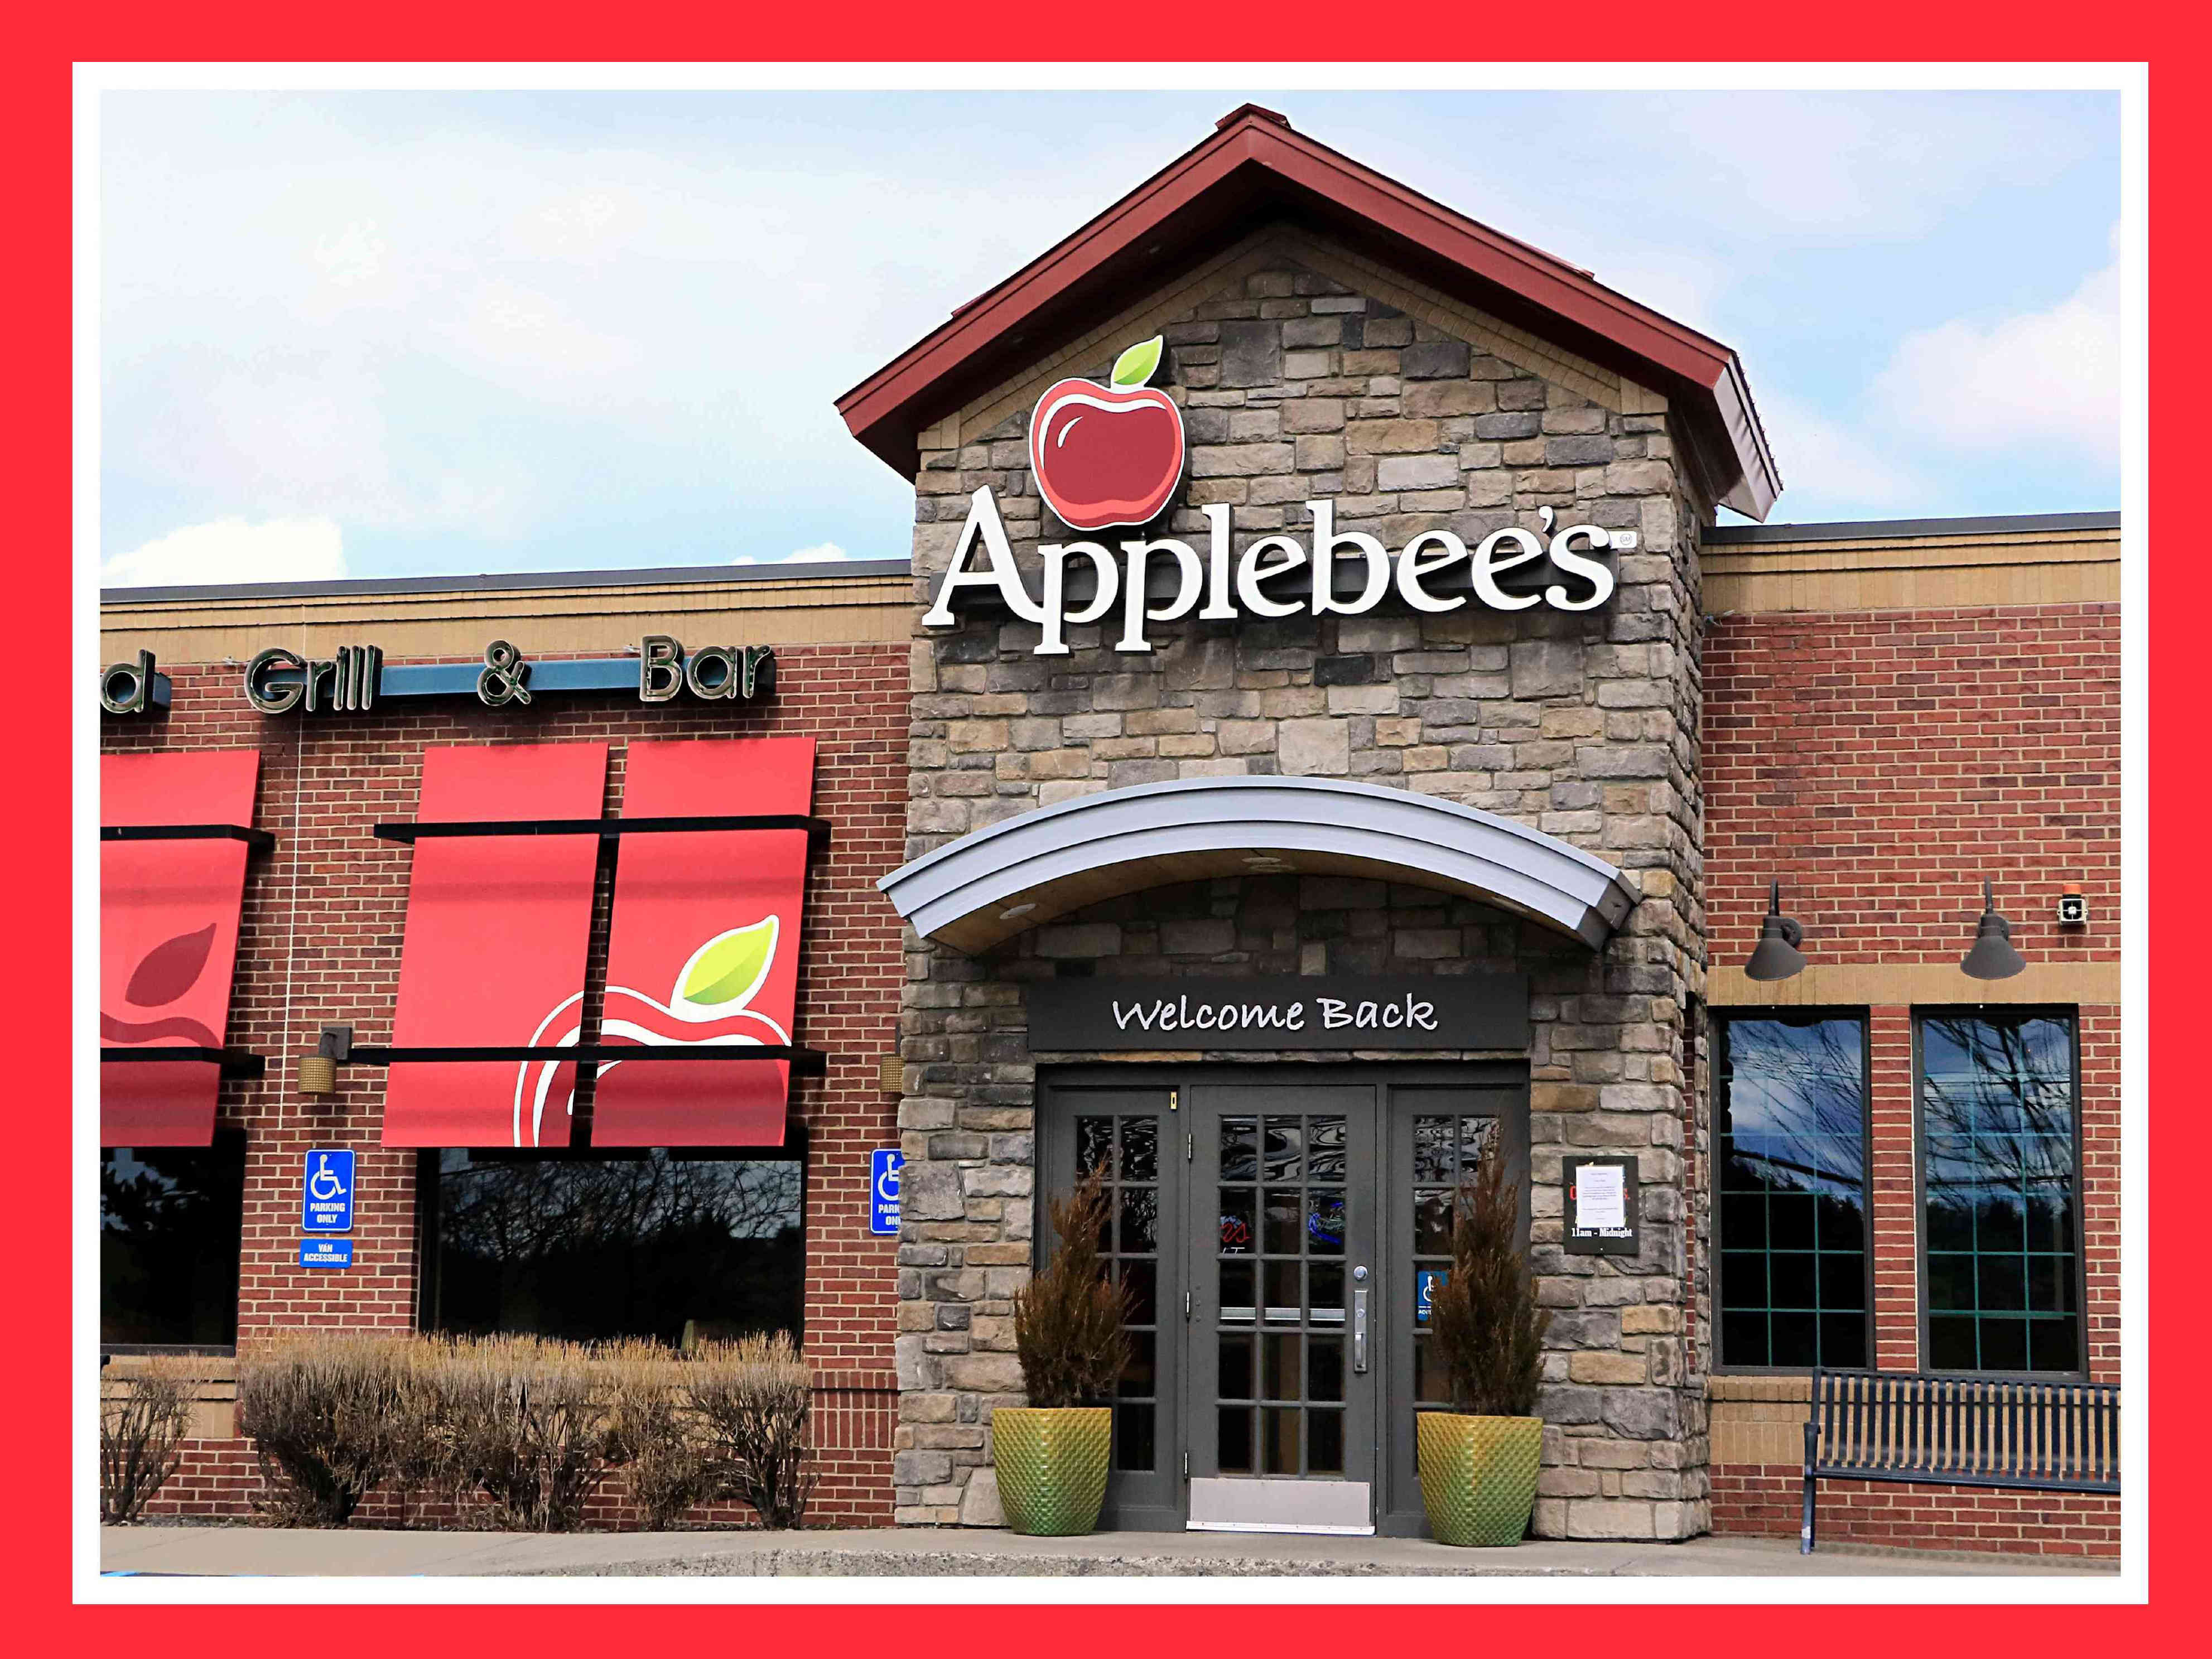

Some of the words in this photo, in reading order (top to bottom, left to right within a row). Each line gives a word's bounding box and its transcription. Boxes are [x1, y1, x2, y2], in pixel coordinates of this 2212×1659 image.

[922, 484, 1615, 655] Applebee's
[244, 645, 376, 714] Grill
[477, 639, 532, 706] &
[639, 634, 772, 702] Bar
[1112, 995, 1305, 1031] Welcome
[1316, 993, 1438, 1031] Back
[310, 1203, 345, 1212] PARKING
[878, 1204, 900, 1214] PARK
[316, 1214, 338, 1224] ONLY
[1572, 1227, 1592, 1237] 11am
[1599, 1227, 1632, 1238] Midnight
[318, 1243, 333, 1253] VAN
[303, 1253, 348, 1262] ACCESSIBLE
